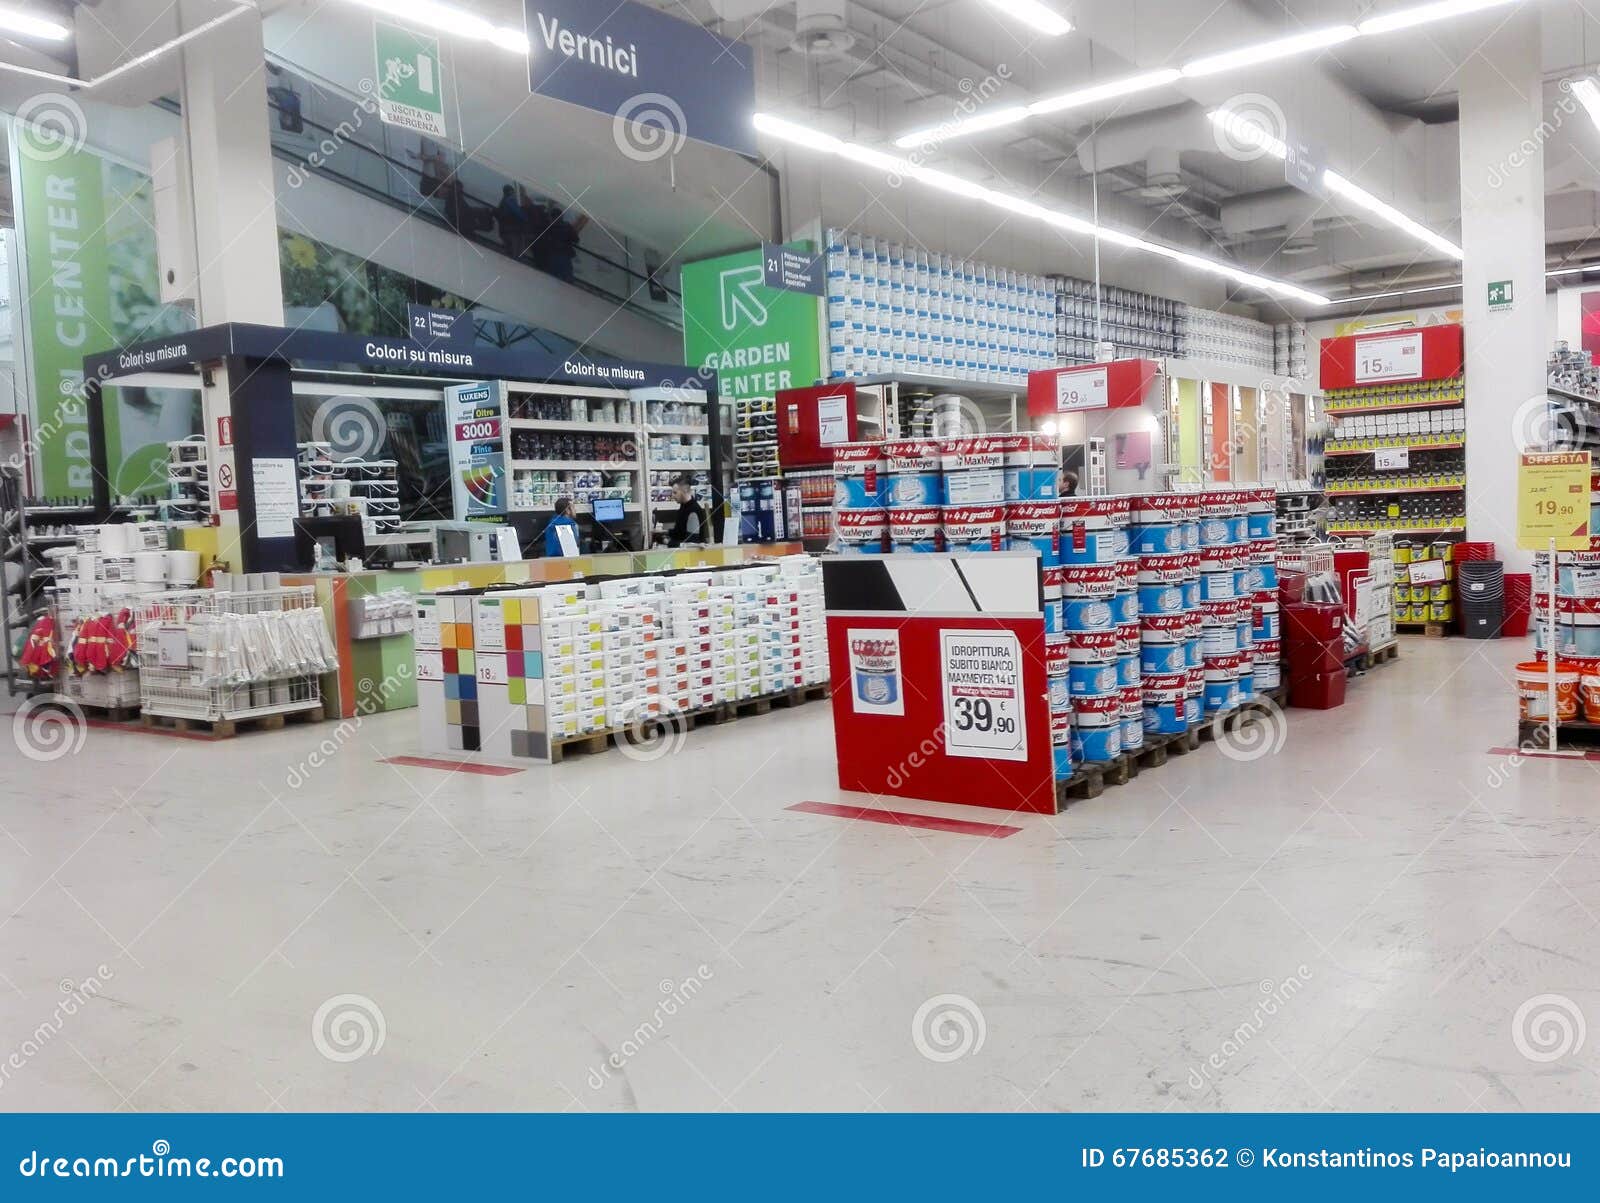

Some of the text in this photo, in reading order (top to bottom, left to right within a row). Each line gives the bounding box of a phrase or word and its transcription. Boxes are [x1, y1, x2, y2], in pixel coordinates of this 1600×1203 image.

[538, 12, 638, 77] Vernici
[392, 103, 434, 122] USCITA DI
[387, 113, 440, 134] EMERGENZA
[46, 175, 87, 347] CENTER
[768, 258, 778, 272] 21
[415, 316, 426, 328] 22
[119, 342, 188, 369] Colori su misura
[365, 343, 473, 366] Colori su misura
[705, 342, 791, 370] GARDEN
[564, 361, 646, 380] Colori su misura
[721, 370, 793, 396] ENTER
[460, 391, 488, 401] LUXENS
[476, 409, 494, 418] Oltre
[462, 423, 492, 440] 3000
[895, 460, 933, 469] MaxMeyer
[1528, 454, 1584, 464] OFFERTA
[1577, 553, 1600, 561] MaxM
[951, 646, 1010, 657] IDROPITTURA
[950, 659, 1013, 672] SUBITO BIANCO
[949, 672, 1016, 685] MAXMEYER 14 LT
